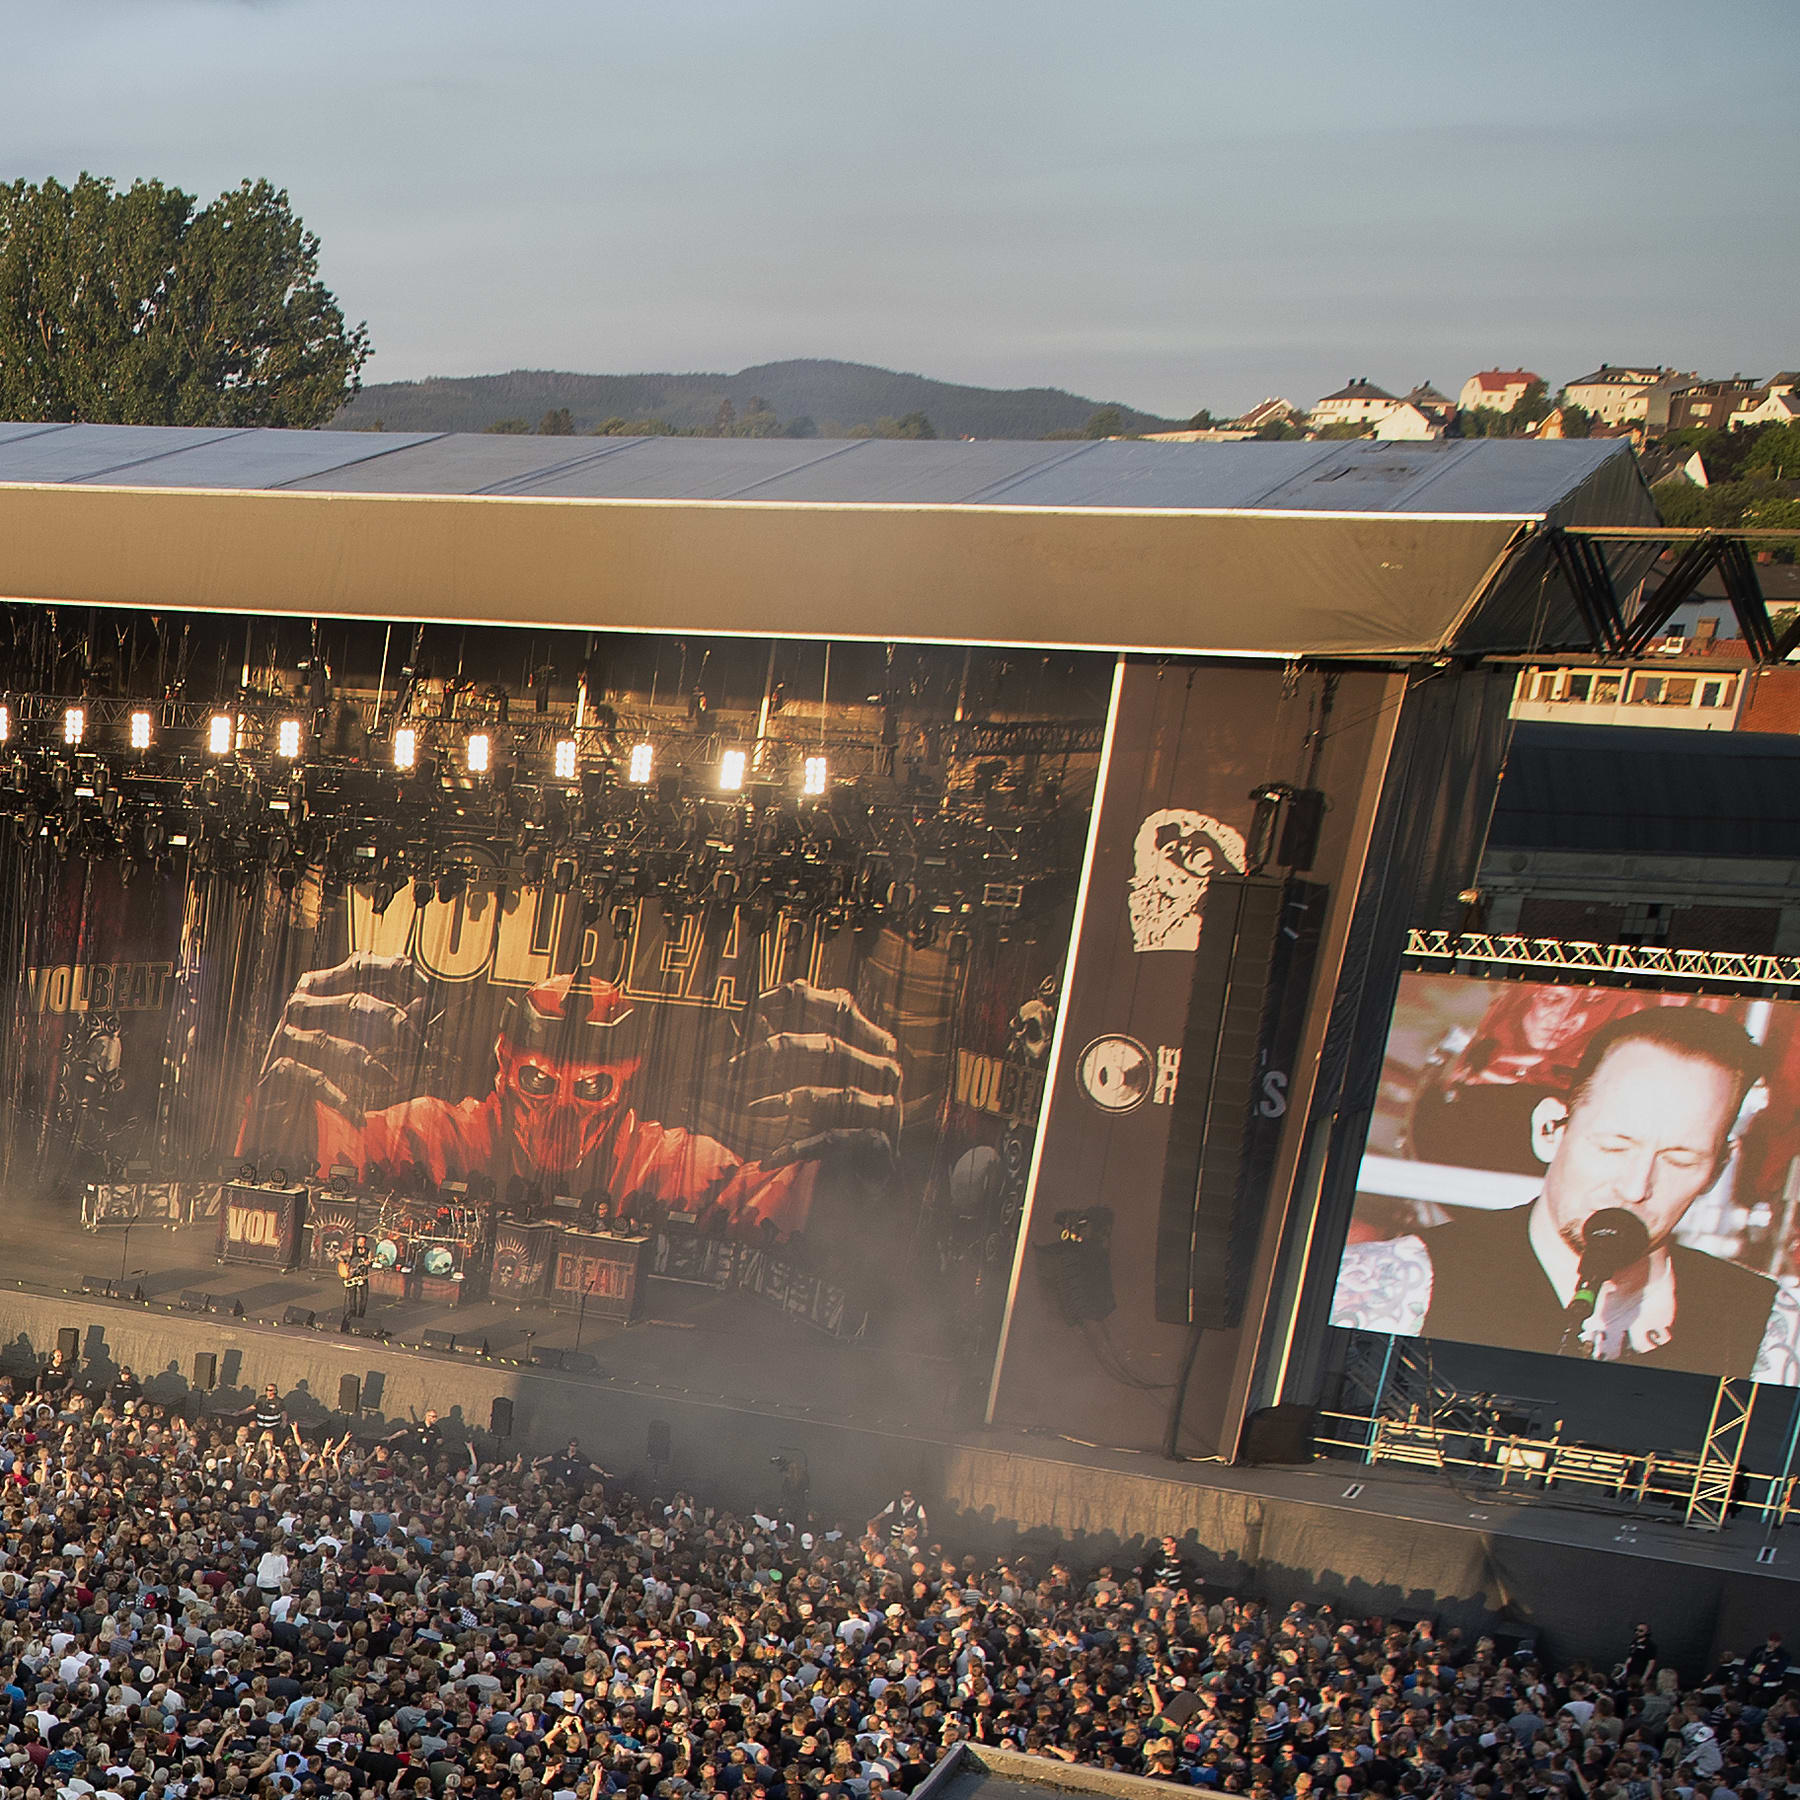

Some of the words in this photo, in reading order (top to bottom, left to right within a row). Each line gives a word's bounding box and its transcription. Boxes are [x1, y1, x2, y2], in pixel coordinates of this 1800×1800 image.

[28, 962, 174, 1016] VOLBEAT
[228, 1206, 280, 1247] VOL
[555, 1252, 635, 1299] BEAT
